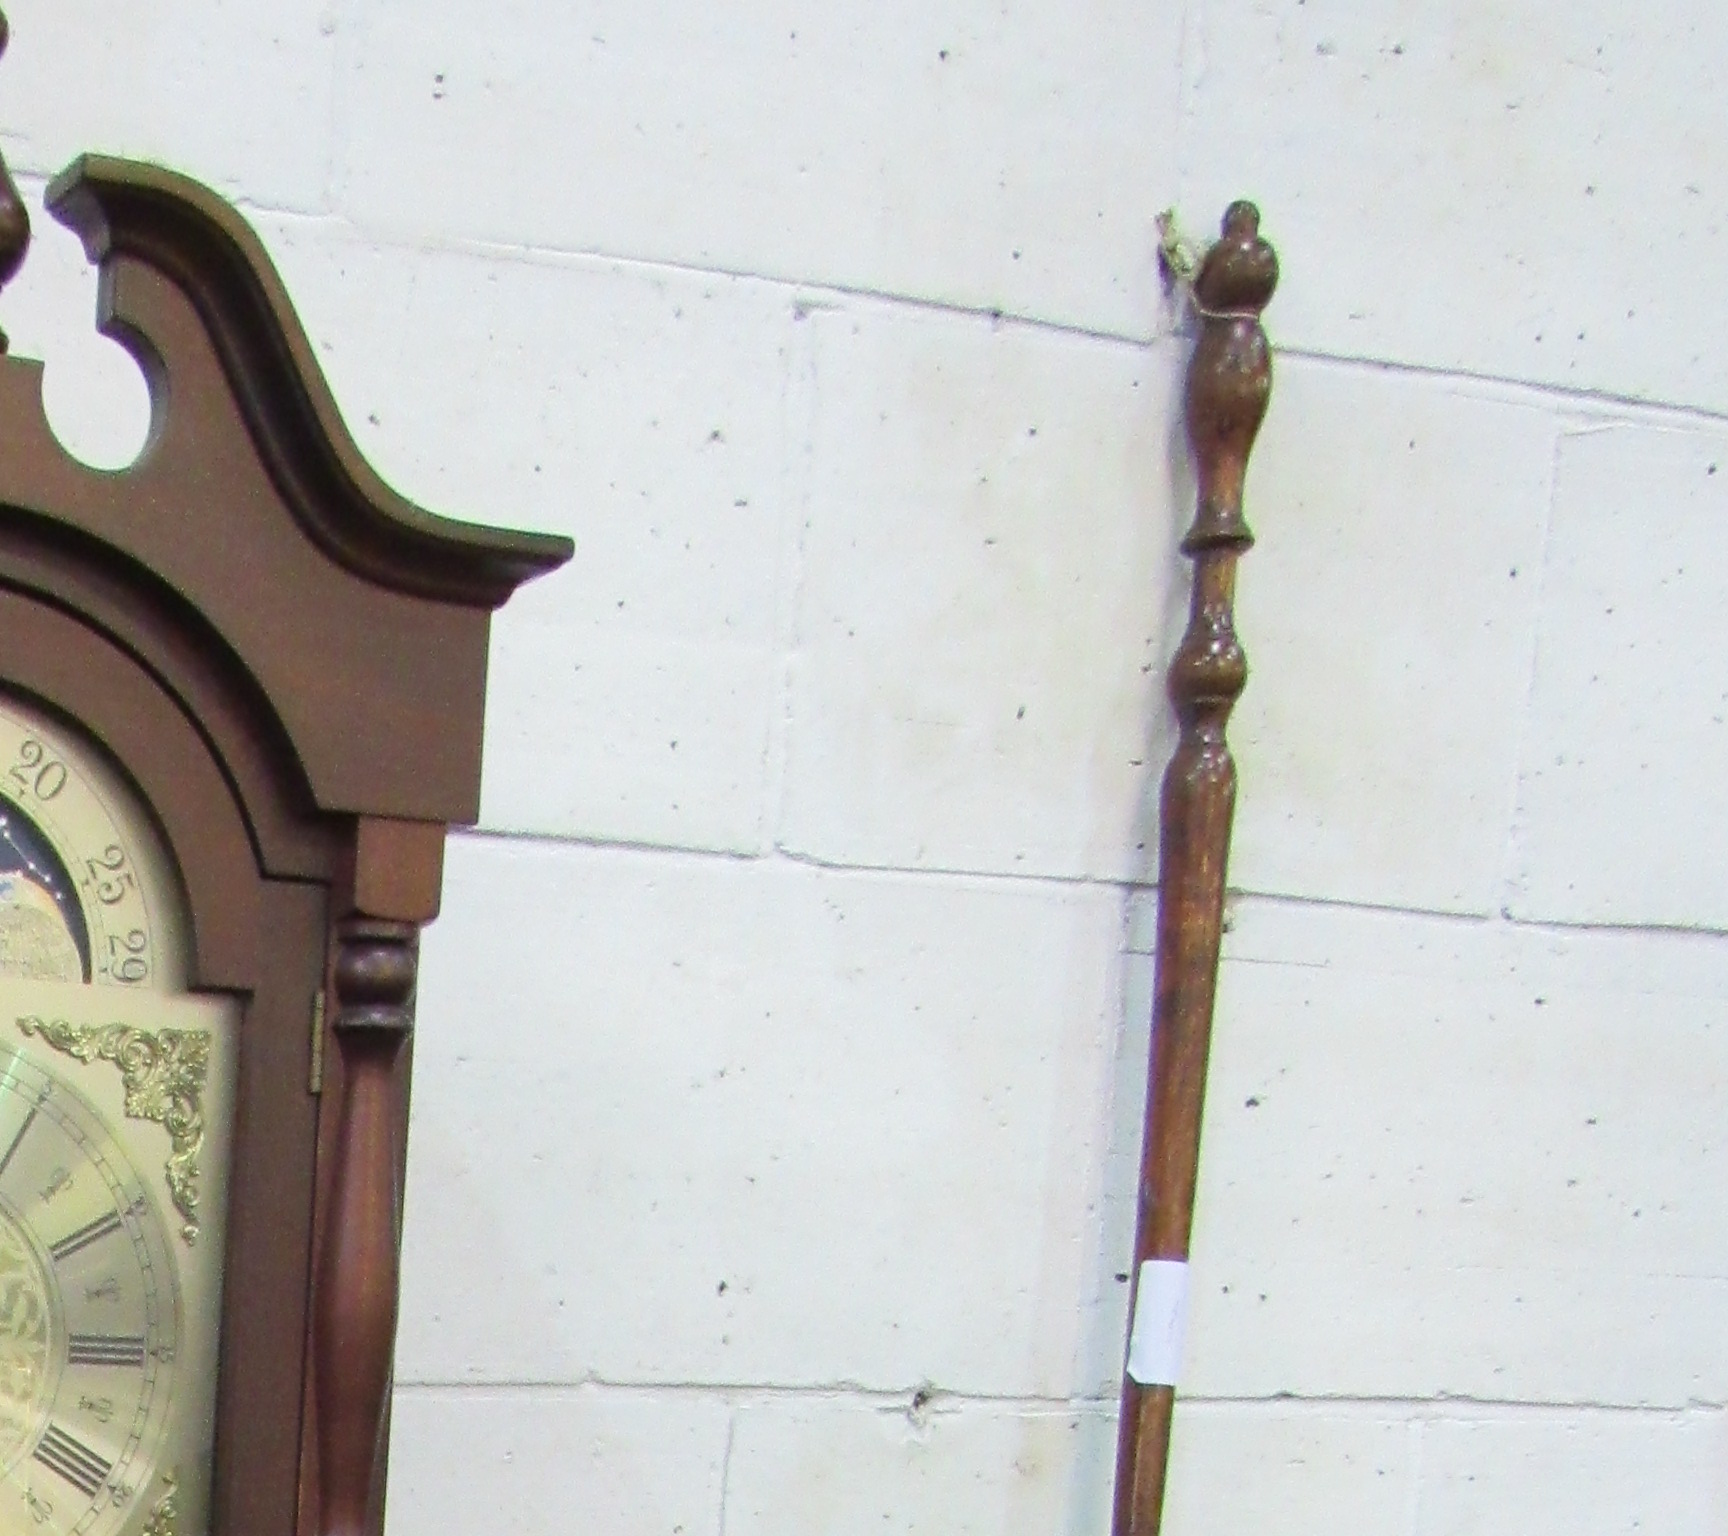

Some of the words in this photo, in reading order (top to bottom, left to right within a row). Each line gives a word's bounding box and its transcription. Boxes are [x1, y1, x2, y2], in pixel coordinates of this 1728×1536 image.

[9, 740, 67, 802] 20
[86, 844, 138, 906] 25
[108, 930, 148, 984] 29
